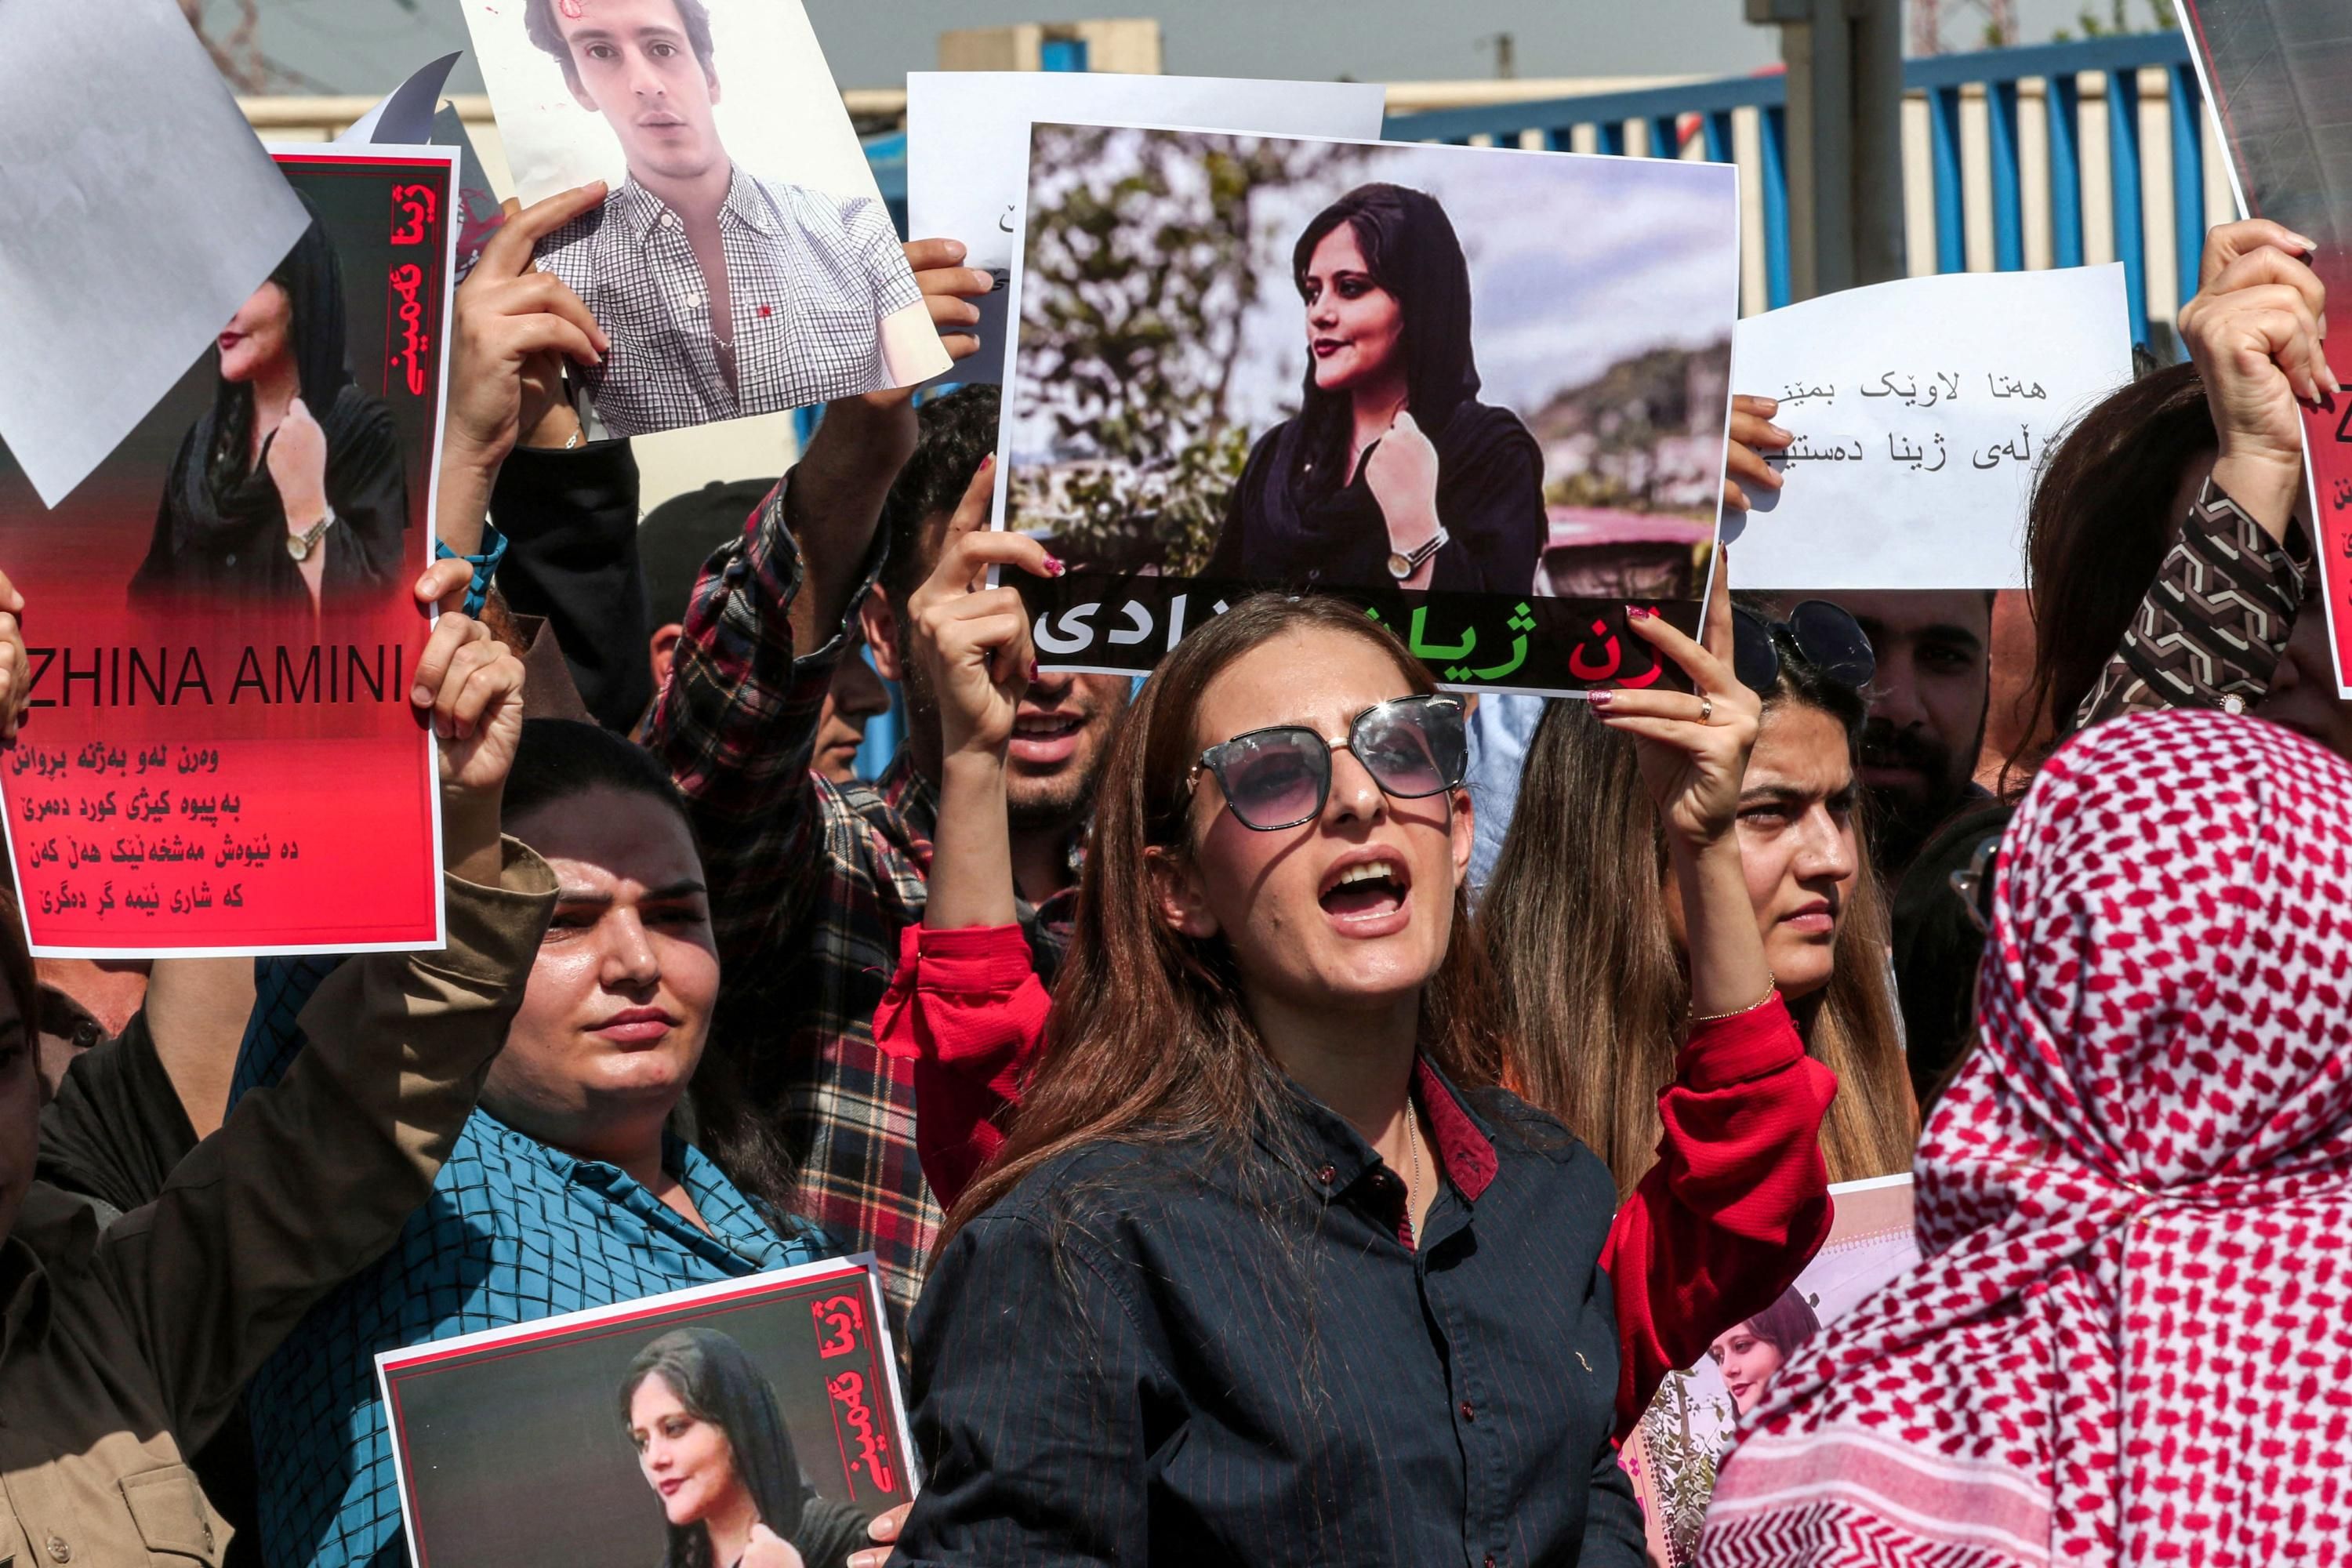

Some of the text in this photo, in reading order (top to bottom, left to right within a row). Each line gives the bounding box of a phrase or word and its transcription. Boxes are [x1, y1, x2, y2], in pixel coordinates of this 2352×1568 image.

[1988, 372, 2047, 400] هەتا
[1888, 432, 1946, 472] ژینا
[27, 644, 401, 707] ZHINA AMINI
